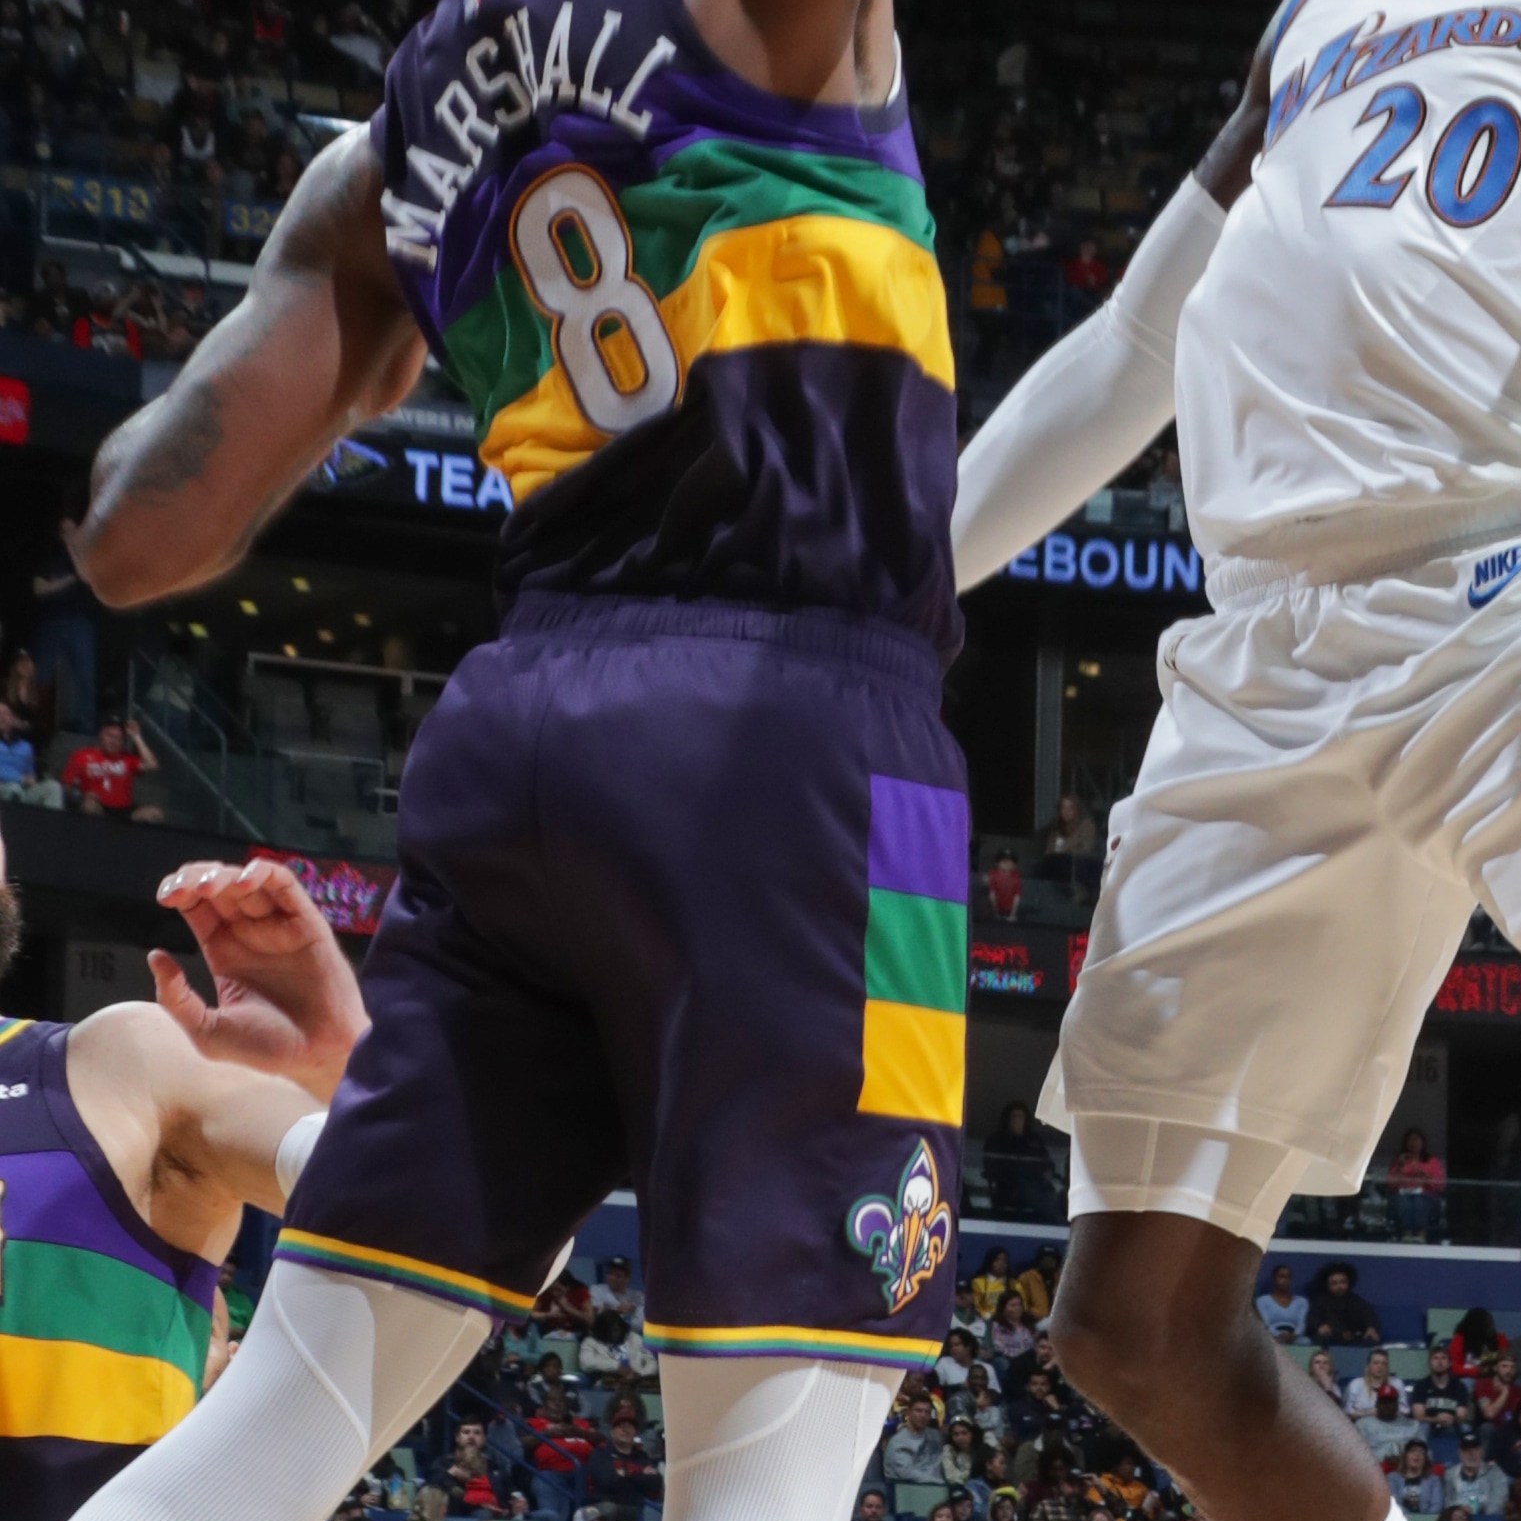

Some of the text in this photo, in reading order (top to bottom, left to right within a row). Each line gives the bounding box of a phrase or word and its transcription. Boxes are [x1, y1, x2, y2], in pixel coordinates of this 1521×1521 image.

[381, 1, 676, 272] MARSHALL
[509, 161, 686, 437] 8
[403, 447, 514, 512] TEA
[997, 532, 1200, 591] EBOUN
